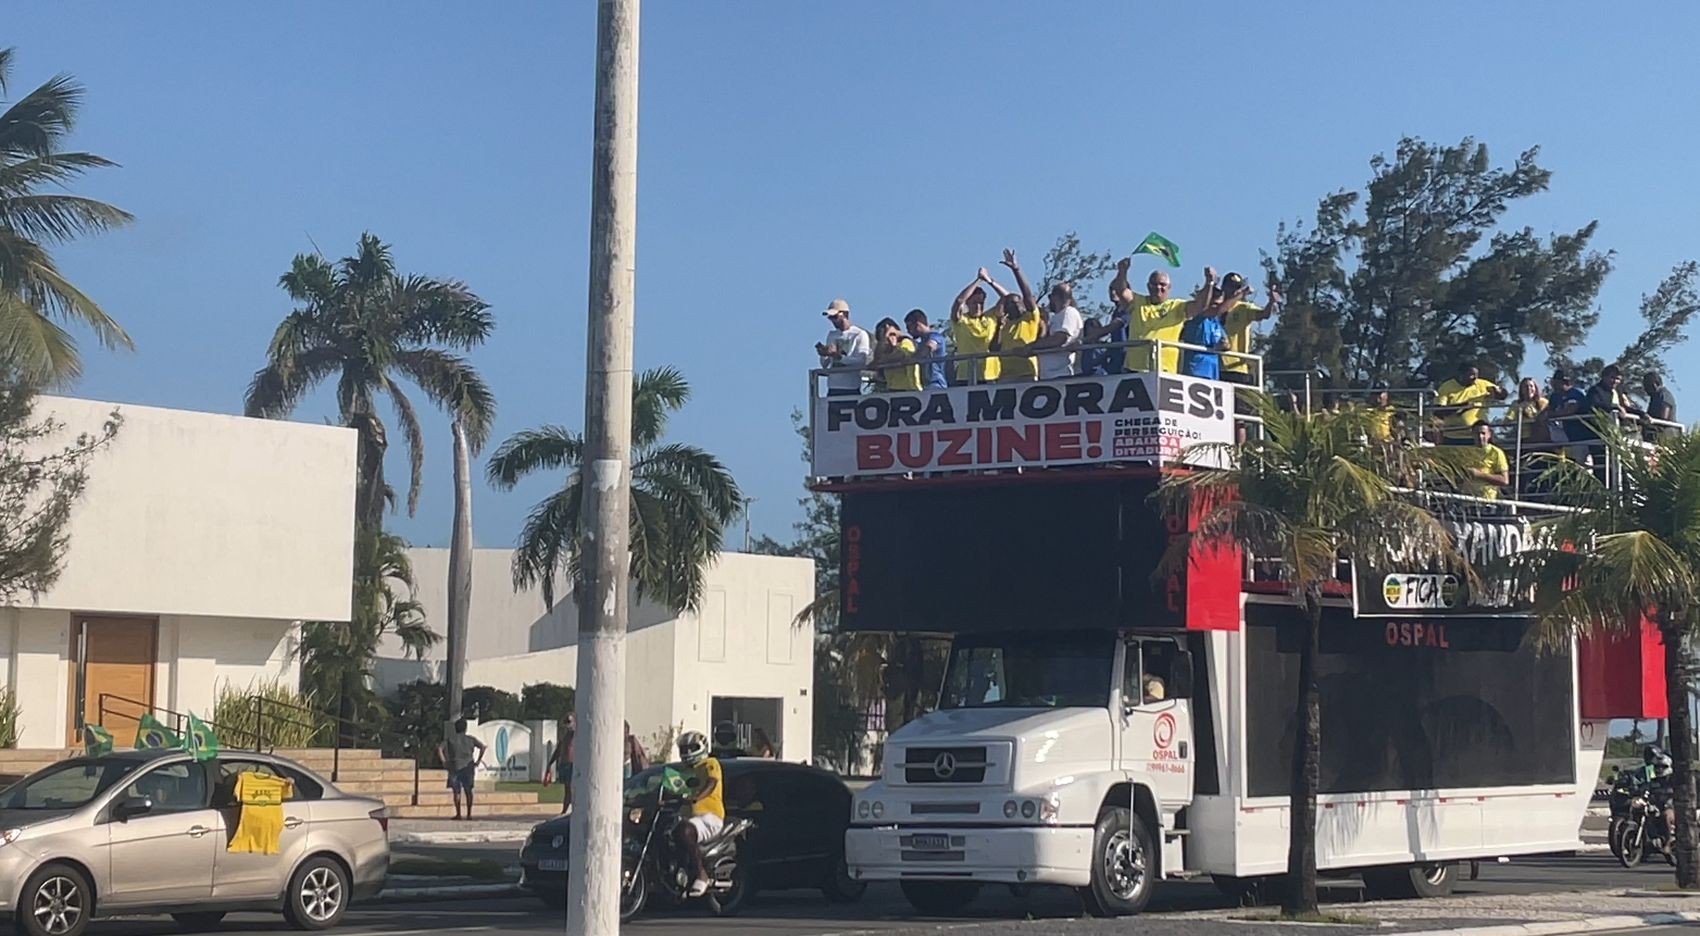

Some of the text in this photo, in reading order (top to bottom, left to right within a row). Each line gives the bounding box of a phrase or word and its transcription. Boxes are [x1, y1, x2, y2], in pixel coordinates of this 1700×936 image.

[827, 378, 1225, 432] FORA MORAES!
[1114, 416, 1178, 427] CHEGA DE
[857, 421, 1103, 470] BUZINE!
[1115, 437, 1179, 446] ABAIXO A
[847, 525, 862, 613] OSPAL
[1405, 576, 1438, 608] FICA
[1386, 621, 1449, 649] OSPAL
[1152, 750, 1178, 760] OSPAL
